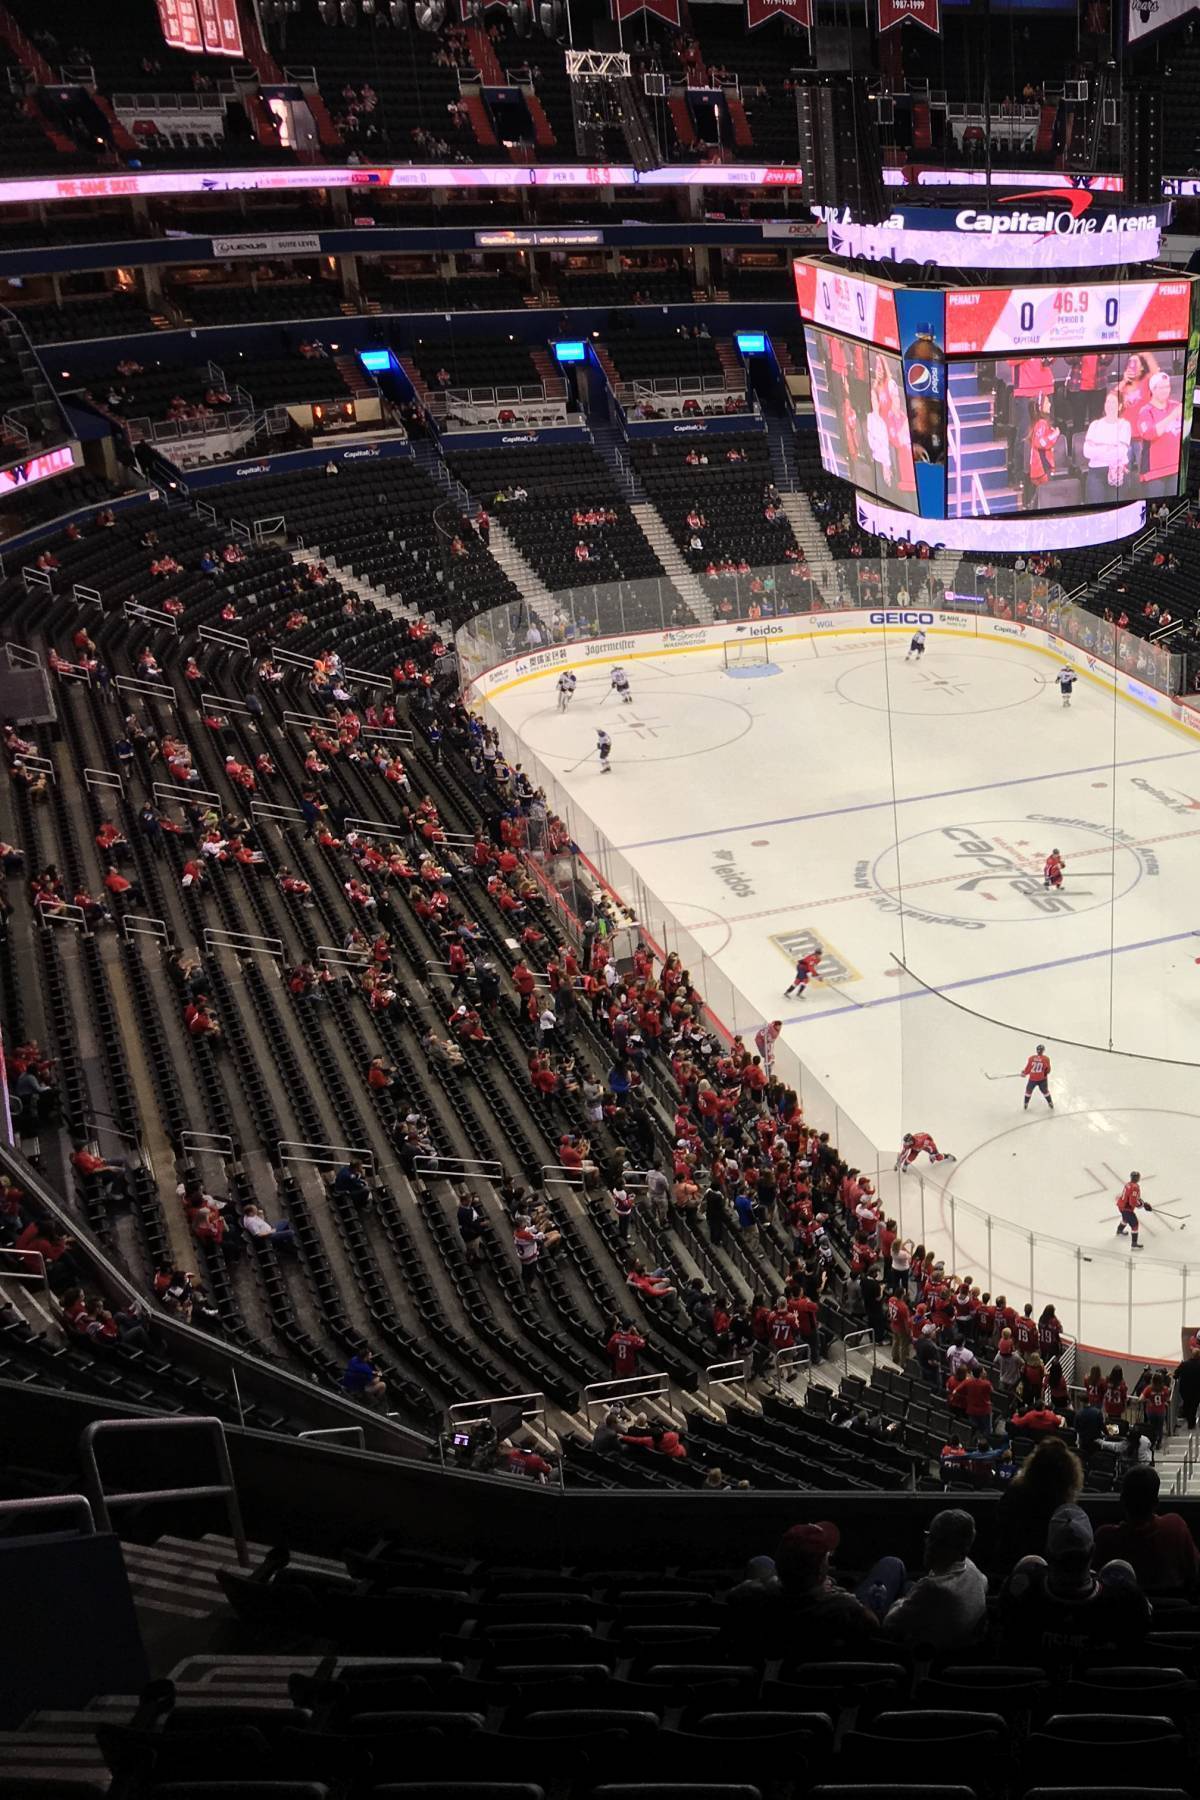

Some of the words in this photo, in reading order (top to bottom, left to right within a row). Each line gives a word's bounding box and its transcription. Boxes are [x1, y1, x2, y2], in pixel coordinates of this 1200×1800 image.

[57, 178, 108, 196] PRE-GAME
[111, 176, 139, 193] SKATE
[1100, 213, 1157, 232] Arena
[788, 225, 813, 234] DEX
[278, 241, 297, 249] SUITE
[1158, 284, 1187, 296] PENALTY
[949, 294, 981, 305] PENALTY
[1053, 291, 1089, 314] 46.9
[1020, 302, 1034, 331] 0
[1105, 297, 1118, 328] 0
[1057, 316, 1078, 324] PERIOD
[1013, 335, 1040, 345] CAPITALS
[931, 366, 940, 394] pepsi
[816, 620, 834, 629] WGL
[870, 613, 934, 625] GEICO
[750, 625, 784, 636] leidos
[663, 638, 706, 648] WASHINGTON
[711, 863, 756, 898] leidos
[773, 1325, 790, 1341] 77
[1017, 1329, 1028, 1343] 19
[618, 1346, 626, 1359] 8
